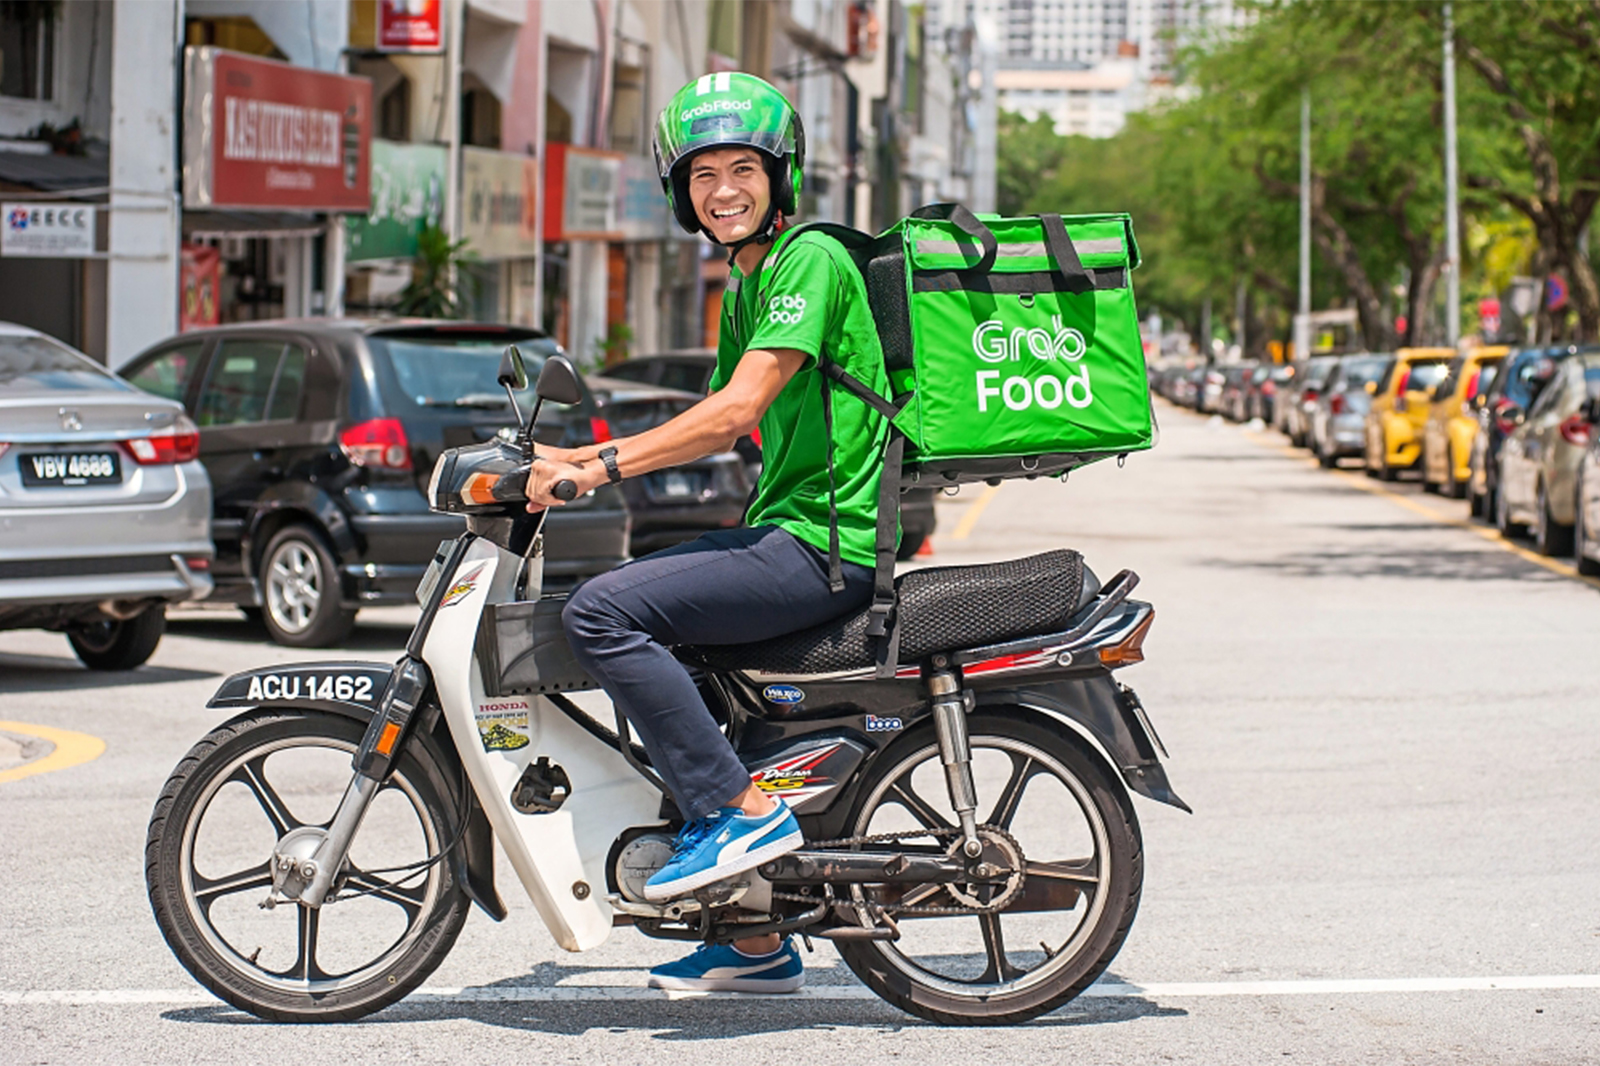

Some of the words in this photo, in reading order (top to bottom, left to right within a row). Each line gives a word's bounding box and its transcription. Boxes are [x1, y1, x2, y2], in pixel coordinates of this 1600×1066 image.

[681, 99, 752, 122] GrabFood
[769, 293, 807, 310] Gab
[769, 310, 804, 324] ood
[971, 314, 1087, 363] Grab
[975, 364, 1093, 413] Food
[32, 456, 66, 478] VBV
[247, 675, 300, 700] ACU
[305, 675, 373, 701] 1462
[479, 702, 528, 712] HONDA
